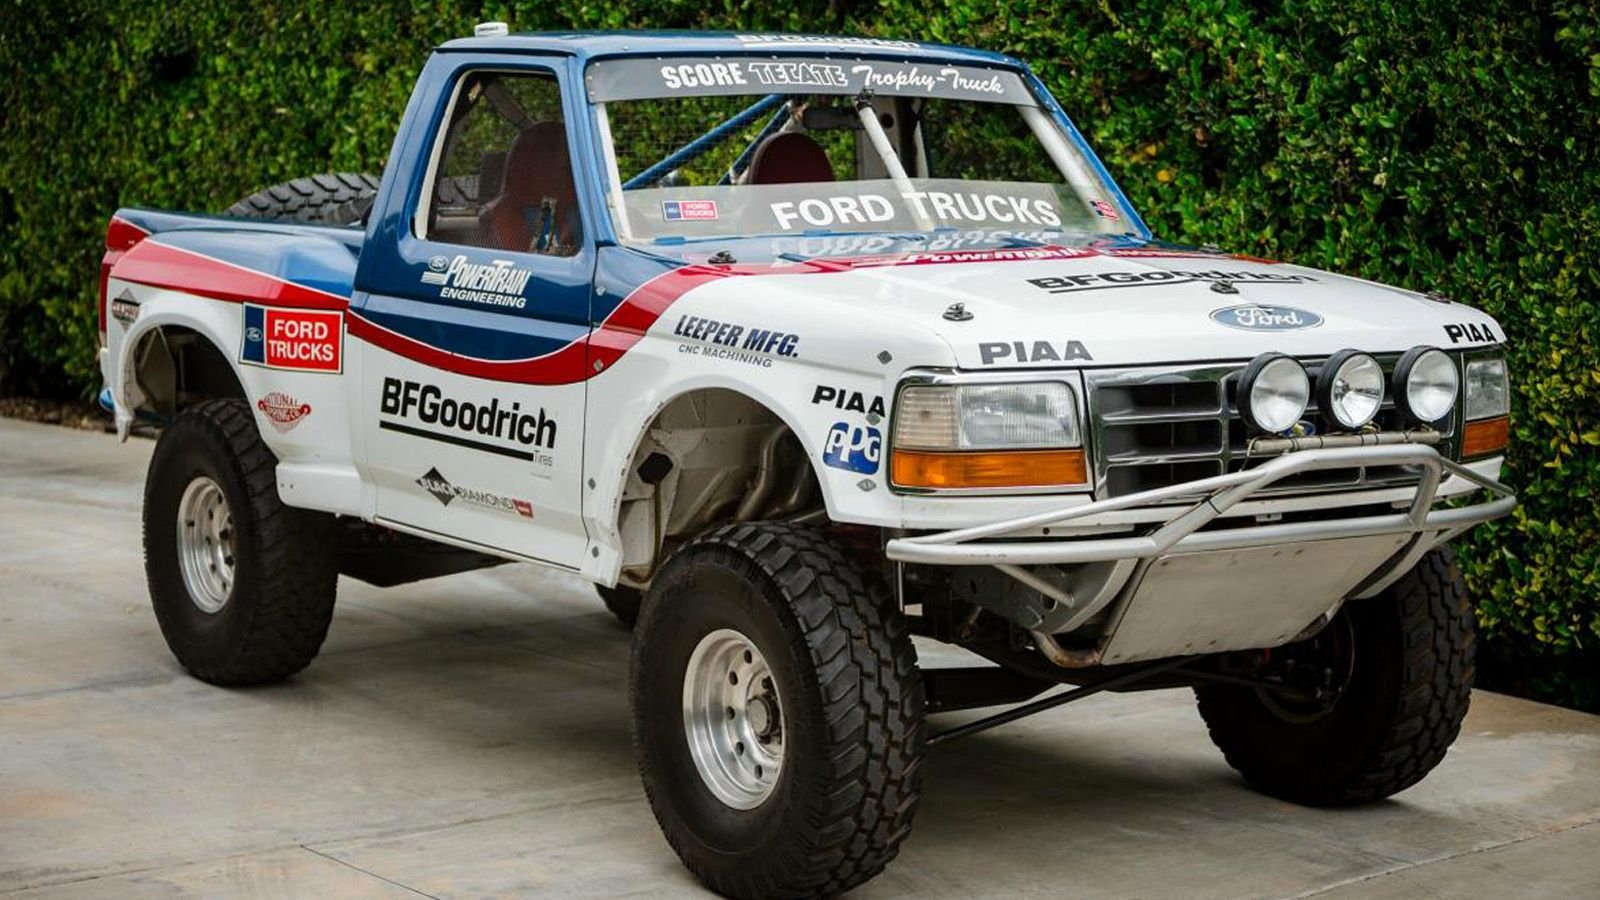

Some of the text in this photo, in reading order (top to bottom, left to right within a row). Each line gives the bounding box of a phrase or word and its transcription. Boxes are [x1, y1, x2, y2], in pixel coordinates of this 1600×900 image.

[661, 62, 1004, 94] SCORE TECATE Trophy-Truck
[771, 194, 894, 231] FORD
[902, 190, 1062, 227] TRUCKS
[1025, 270, 1318, 289] BFGoodrich
[440, 287, 527, 309] ENGINEERING
[1233, 306, 1303, 327] Ford
[274, 319, 328, 340] FORD
[674, 315, 800, 358] LEEPER MFG.
[1444, 323, 1497, 343] PIAA
[268, 340, 335, 361] TRUCKS
[678, 343, 773, 368] CNC MACHINING
[979, 340, 1093, 365] PIAA
[380, 377, 557, 449] BFGoodrich
[811, 385, 887, 418] PIAA
[826, 424, 881, 462] PPG
[532, 450, 553, 467] Tires
